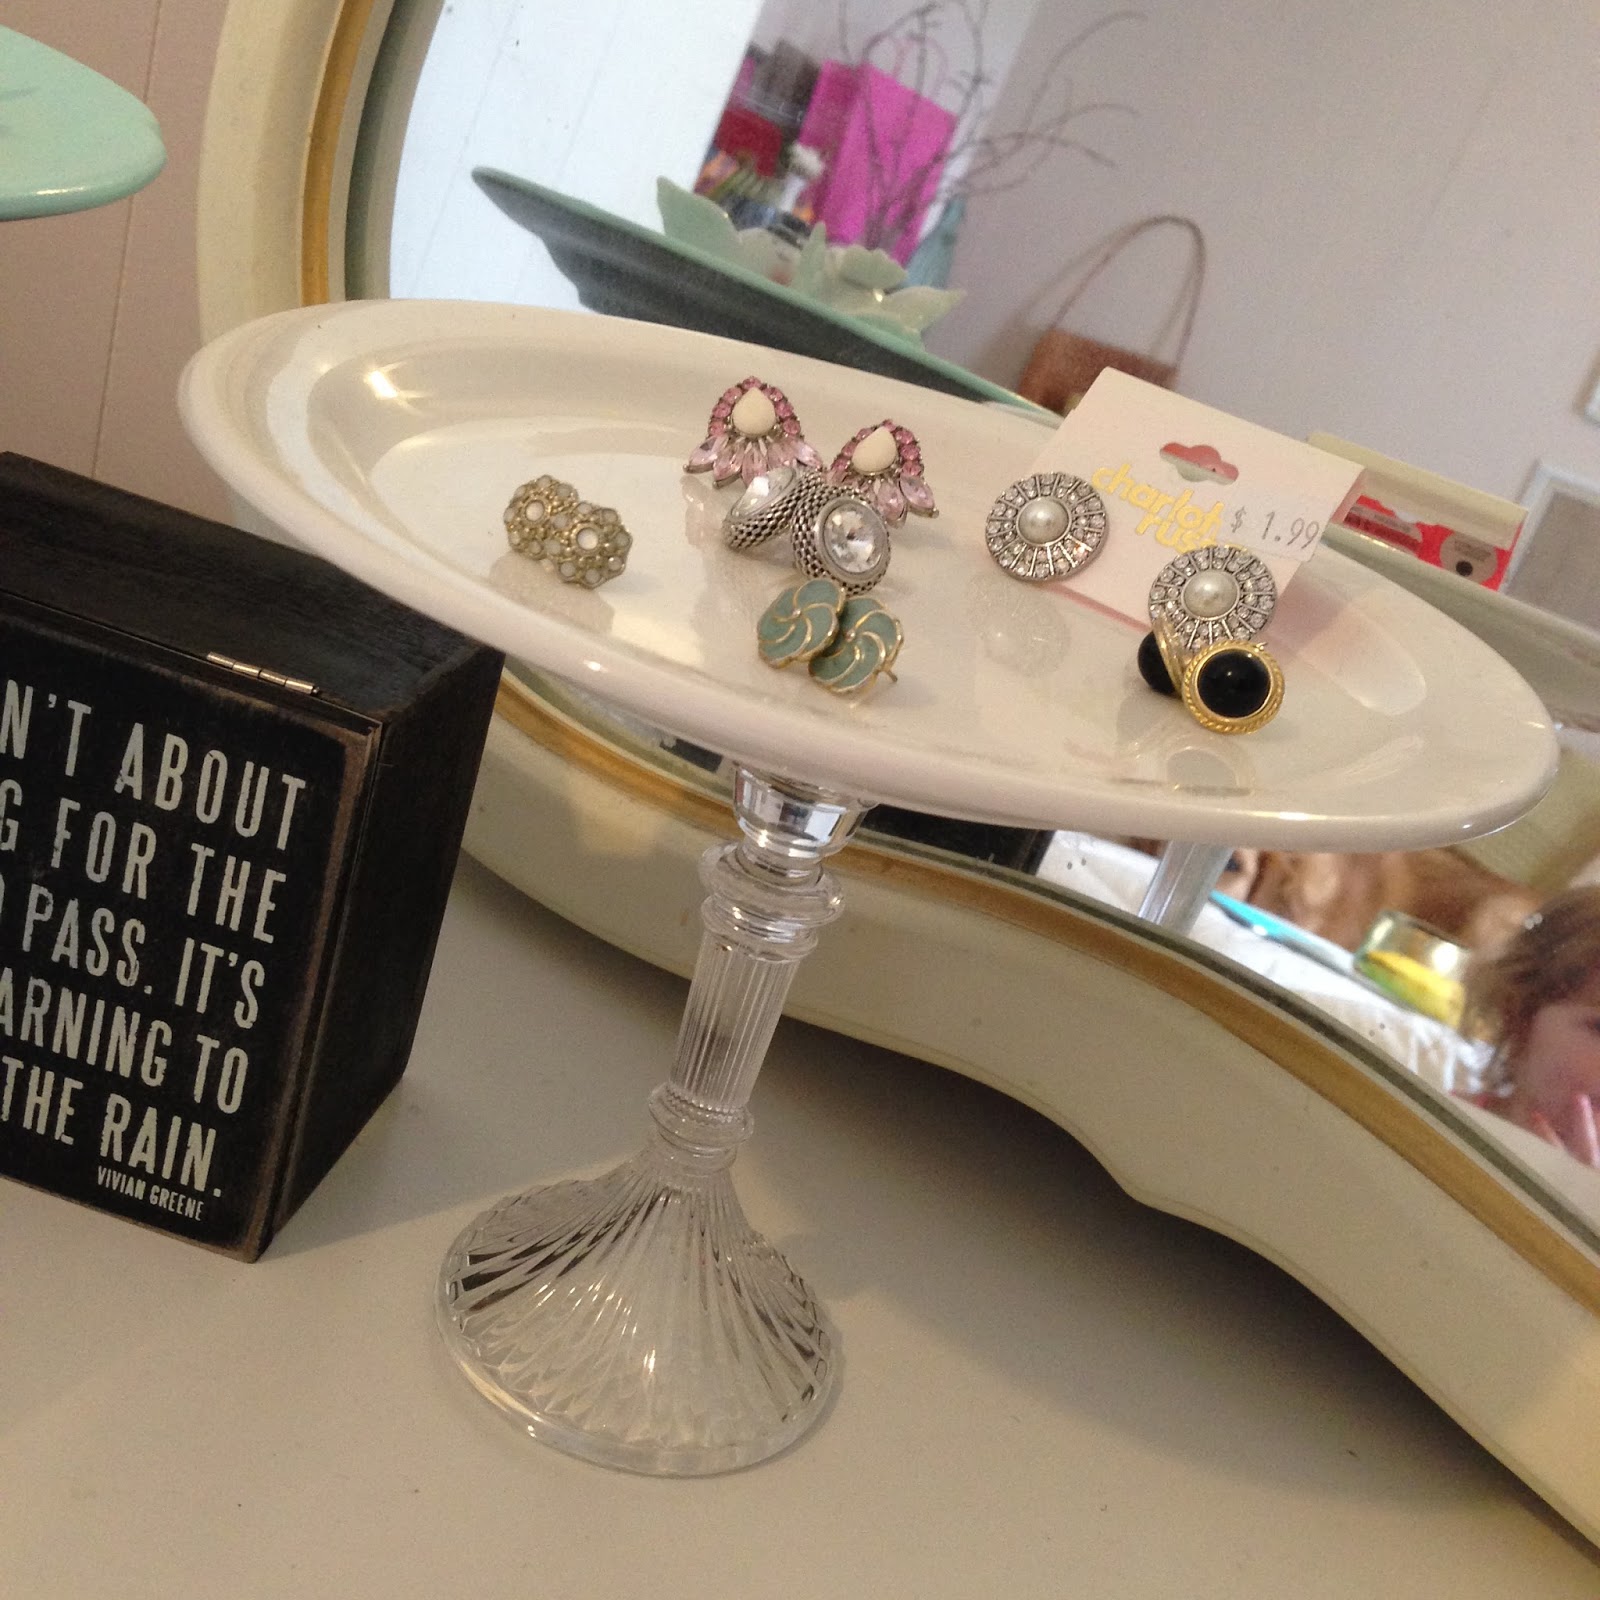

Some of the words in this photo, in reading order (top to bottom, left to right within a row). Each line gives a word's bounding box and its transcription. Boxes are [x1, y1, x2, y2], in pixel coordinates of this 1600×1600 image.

[1091, 462, 1226, 541] charlot
[114, 722, 306, 851] ABOUT
[51, 797, 157, 900] FOR
[186, 842, 287, 944] THE
[22, 883, 153, 995] PASS.
[174, 937, 266, 1029] IT'S
[0, 966, 173, 1087] ARNING
[193, 1034, 249, 1114] TO
[0, 1055, 84, 1145] THE
[99, 1093, 222, 1198] RAIN.
[97, 1165, 146, 1200] VIVIAN
[149, 1184, 204, 1221] GREENE
